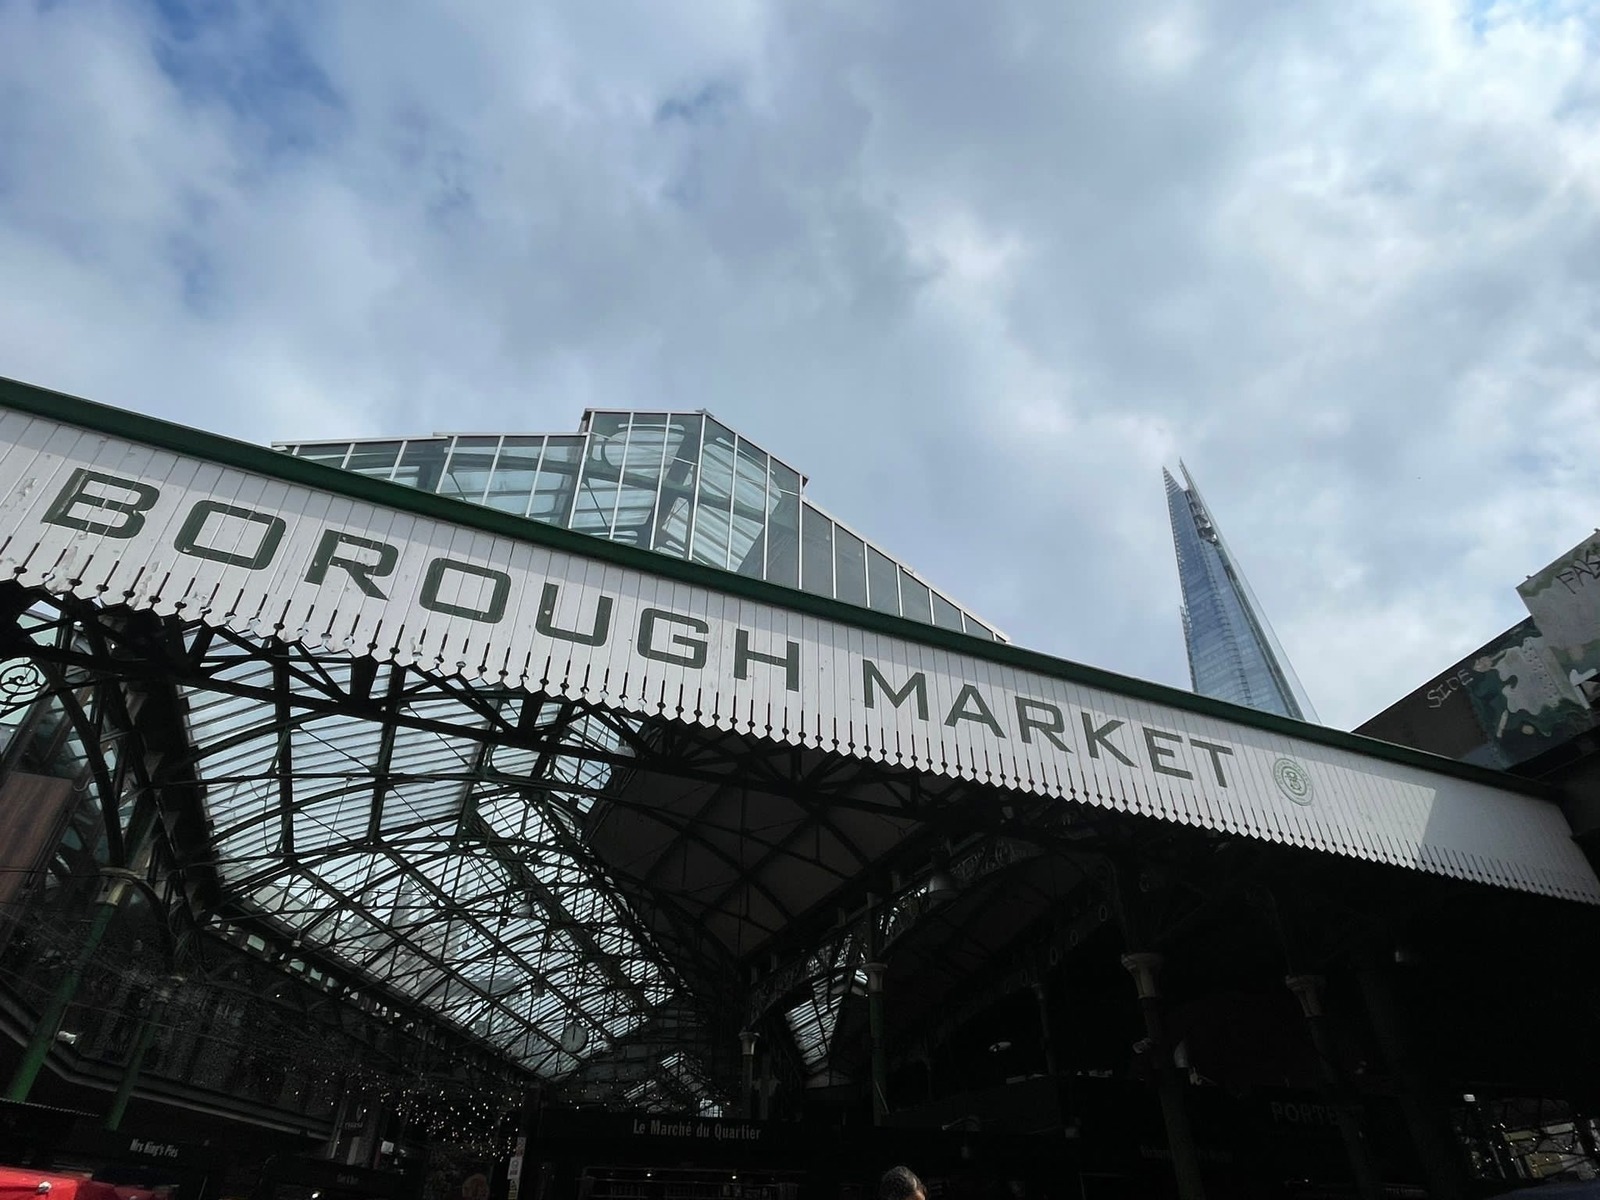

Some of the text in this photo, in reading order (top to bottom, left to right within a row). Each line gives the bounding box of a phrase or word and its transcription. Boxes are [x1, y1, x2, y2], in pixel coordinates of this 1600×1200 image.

[41, 468, 1234, 787] BOROUGH MARKET
[633, 1118, 762, 1141] Le Marché du Quartier
